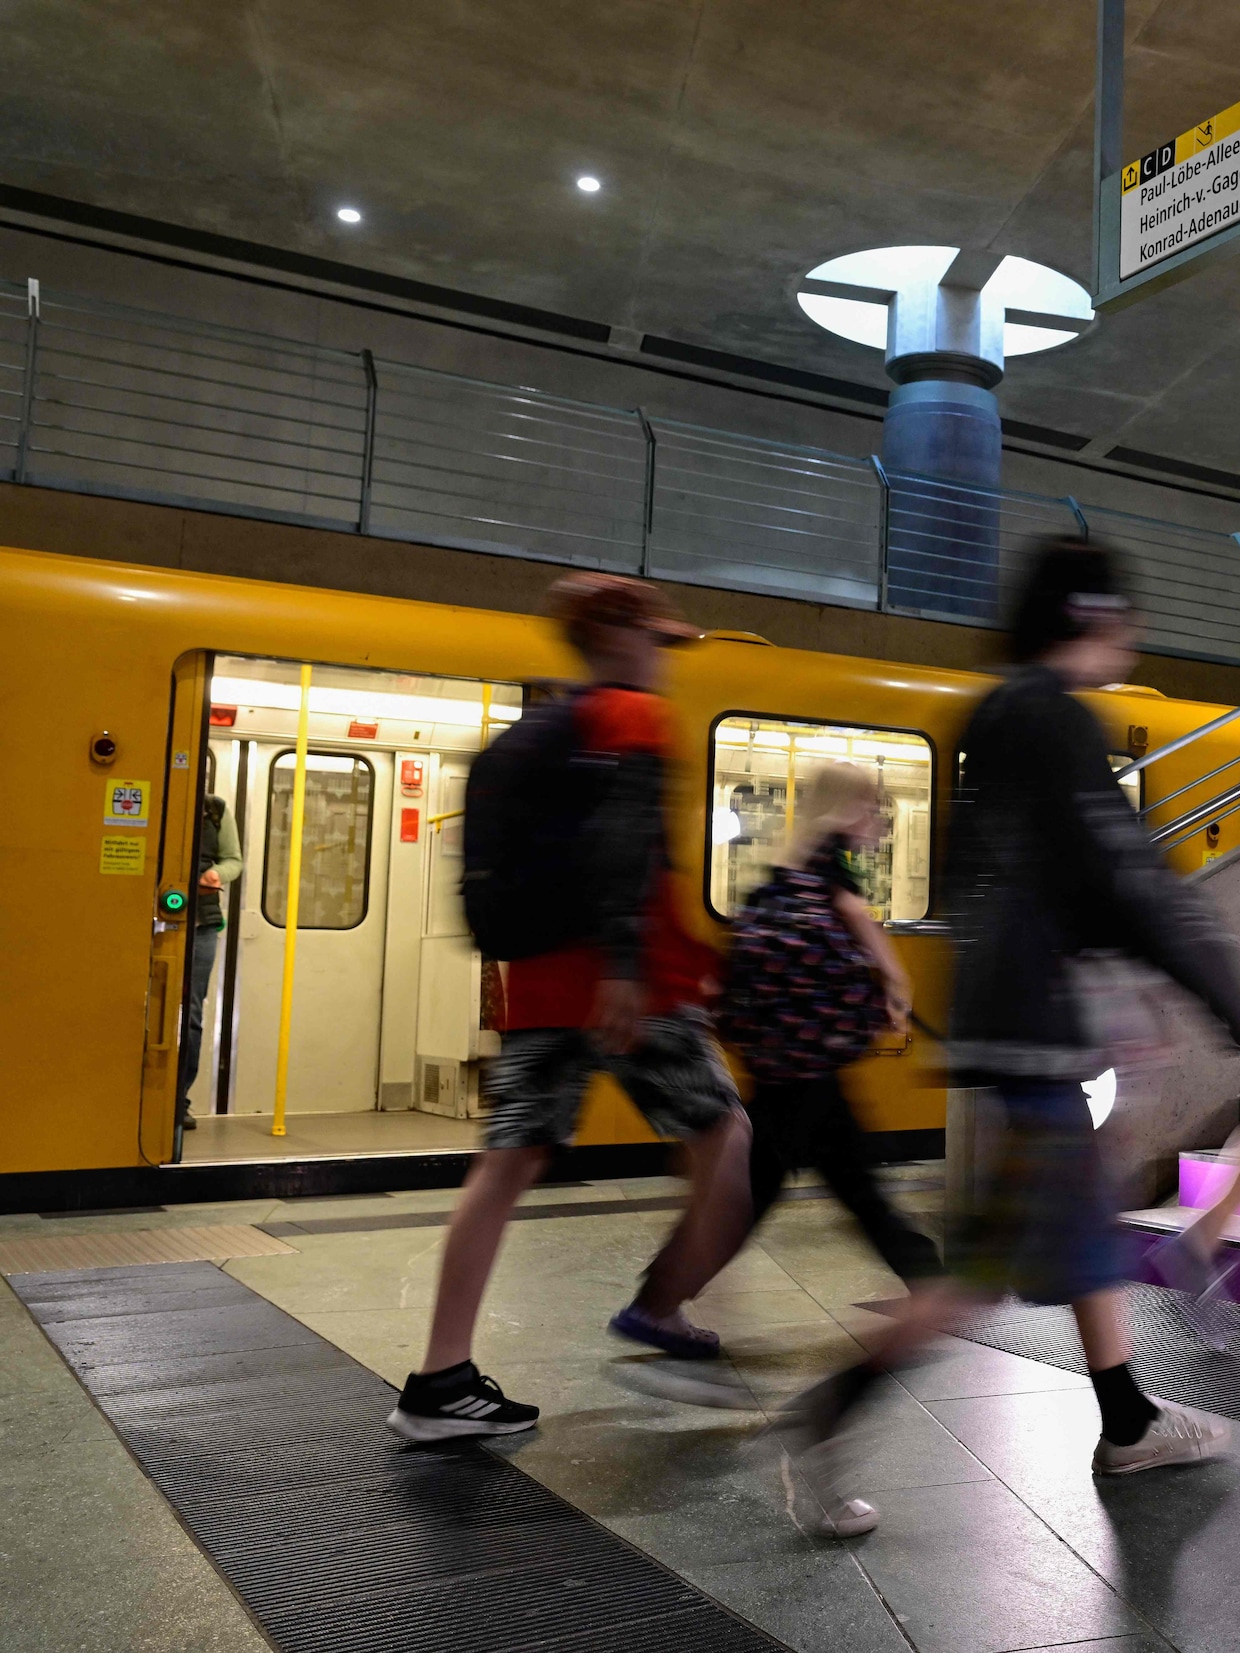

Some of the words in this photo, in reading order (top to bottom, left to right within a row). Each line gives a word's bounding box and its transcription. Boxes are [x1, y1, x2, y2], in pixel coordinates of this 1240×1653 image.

[1140, 139, 1240, 206] Paul-Löbe-Allee
[1143, 156, 1153, 176] C
[1162, 146, 1172, 167] D
